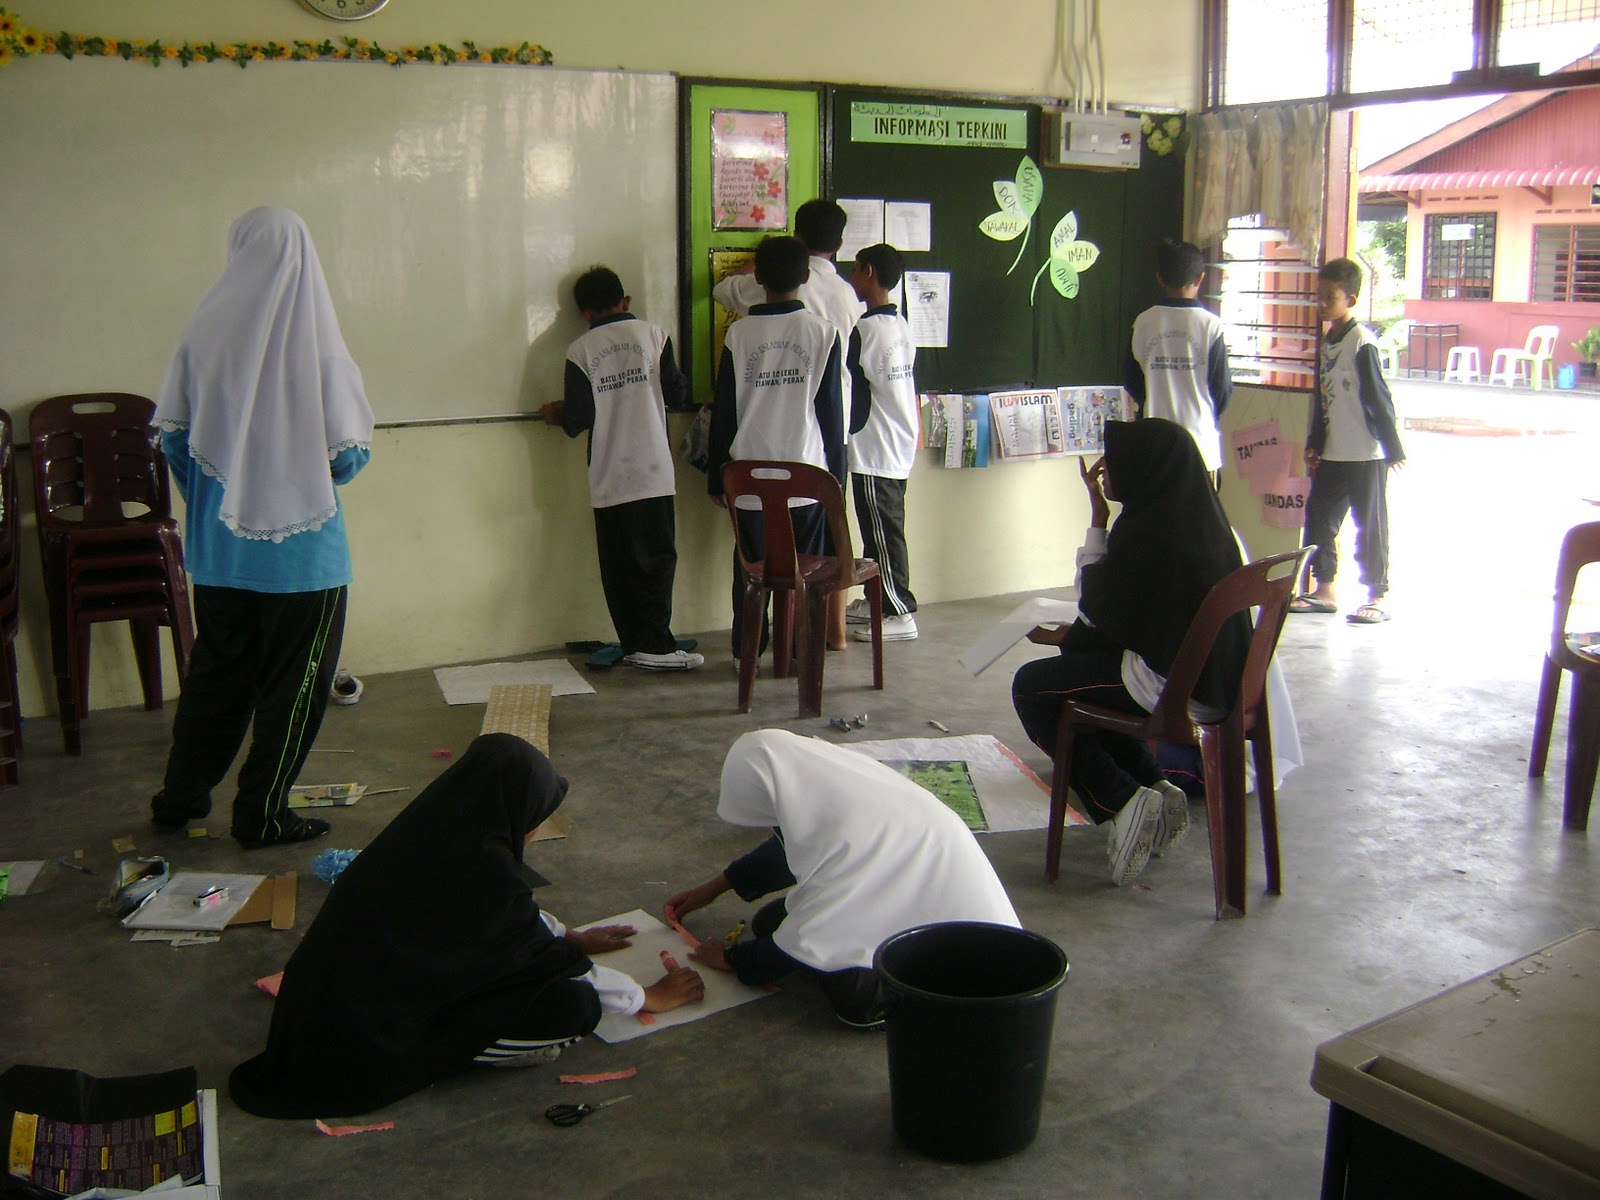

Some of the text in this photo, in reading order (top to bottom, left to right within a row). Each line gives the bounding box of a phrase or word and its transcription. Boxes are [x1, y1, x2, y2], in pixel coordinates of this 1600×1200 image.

[874, 117, 1007, 141] INFORMASI TERKINI
[1022, 166, 1036, 204] USAHA
[998, 186, 1017, 214] DOA
[986, 222, 1022, 233] TAWAKAL
[1053, 223, 1076, 248] AMAL
[1067, 247, 1092, 263] IMAN
[1264, 493, 1304, 508] TANDAS
